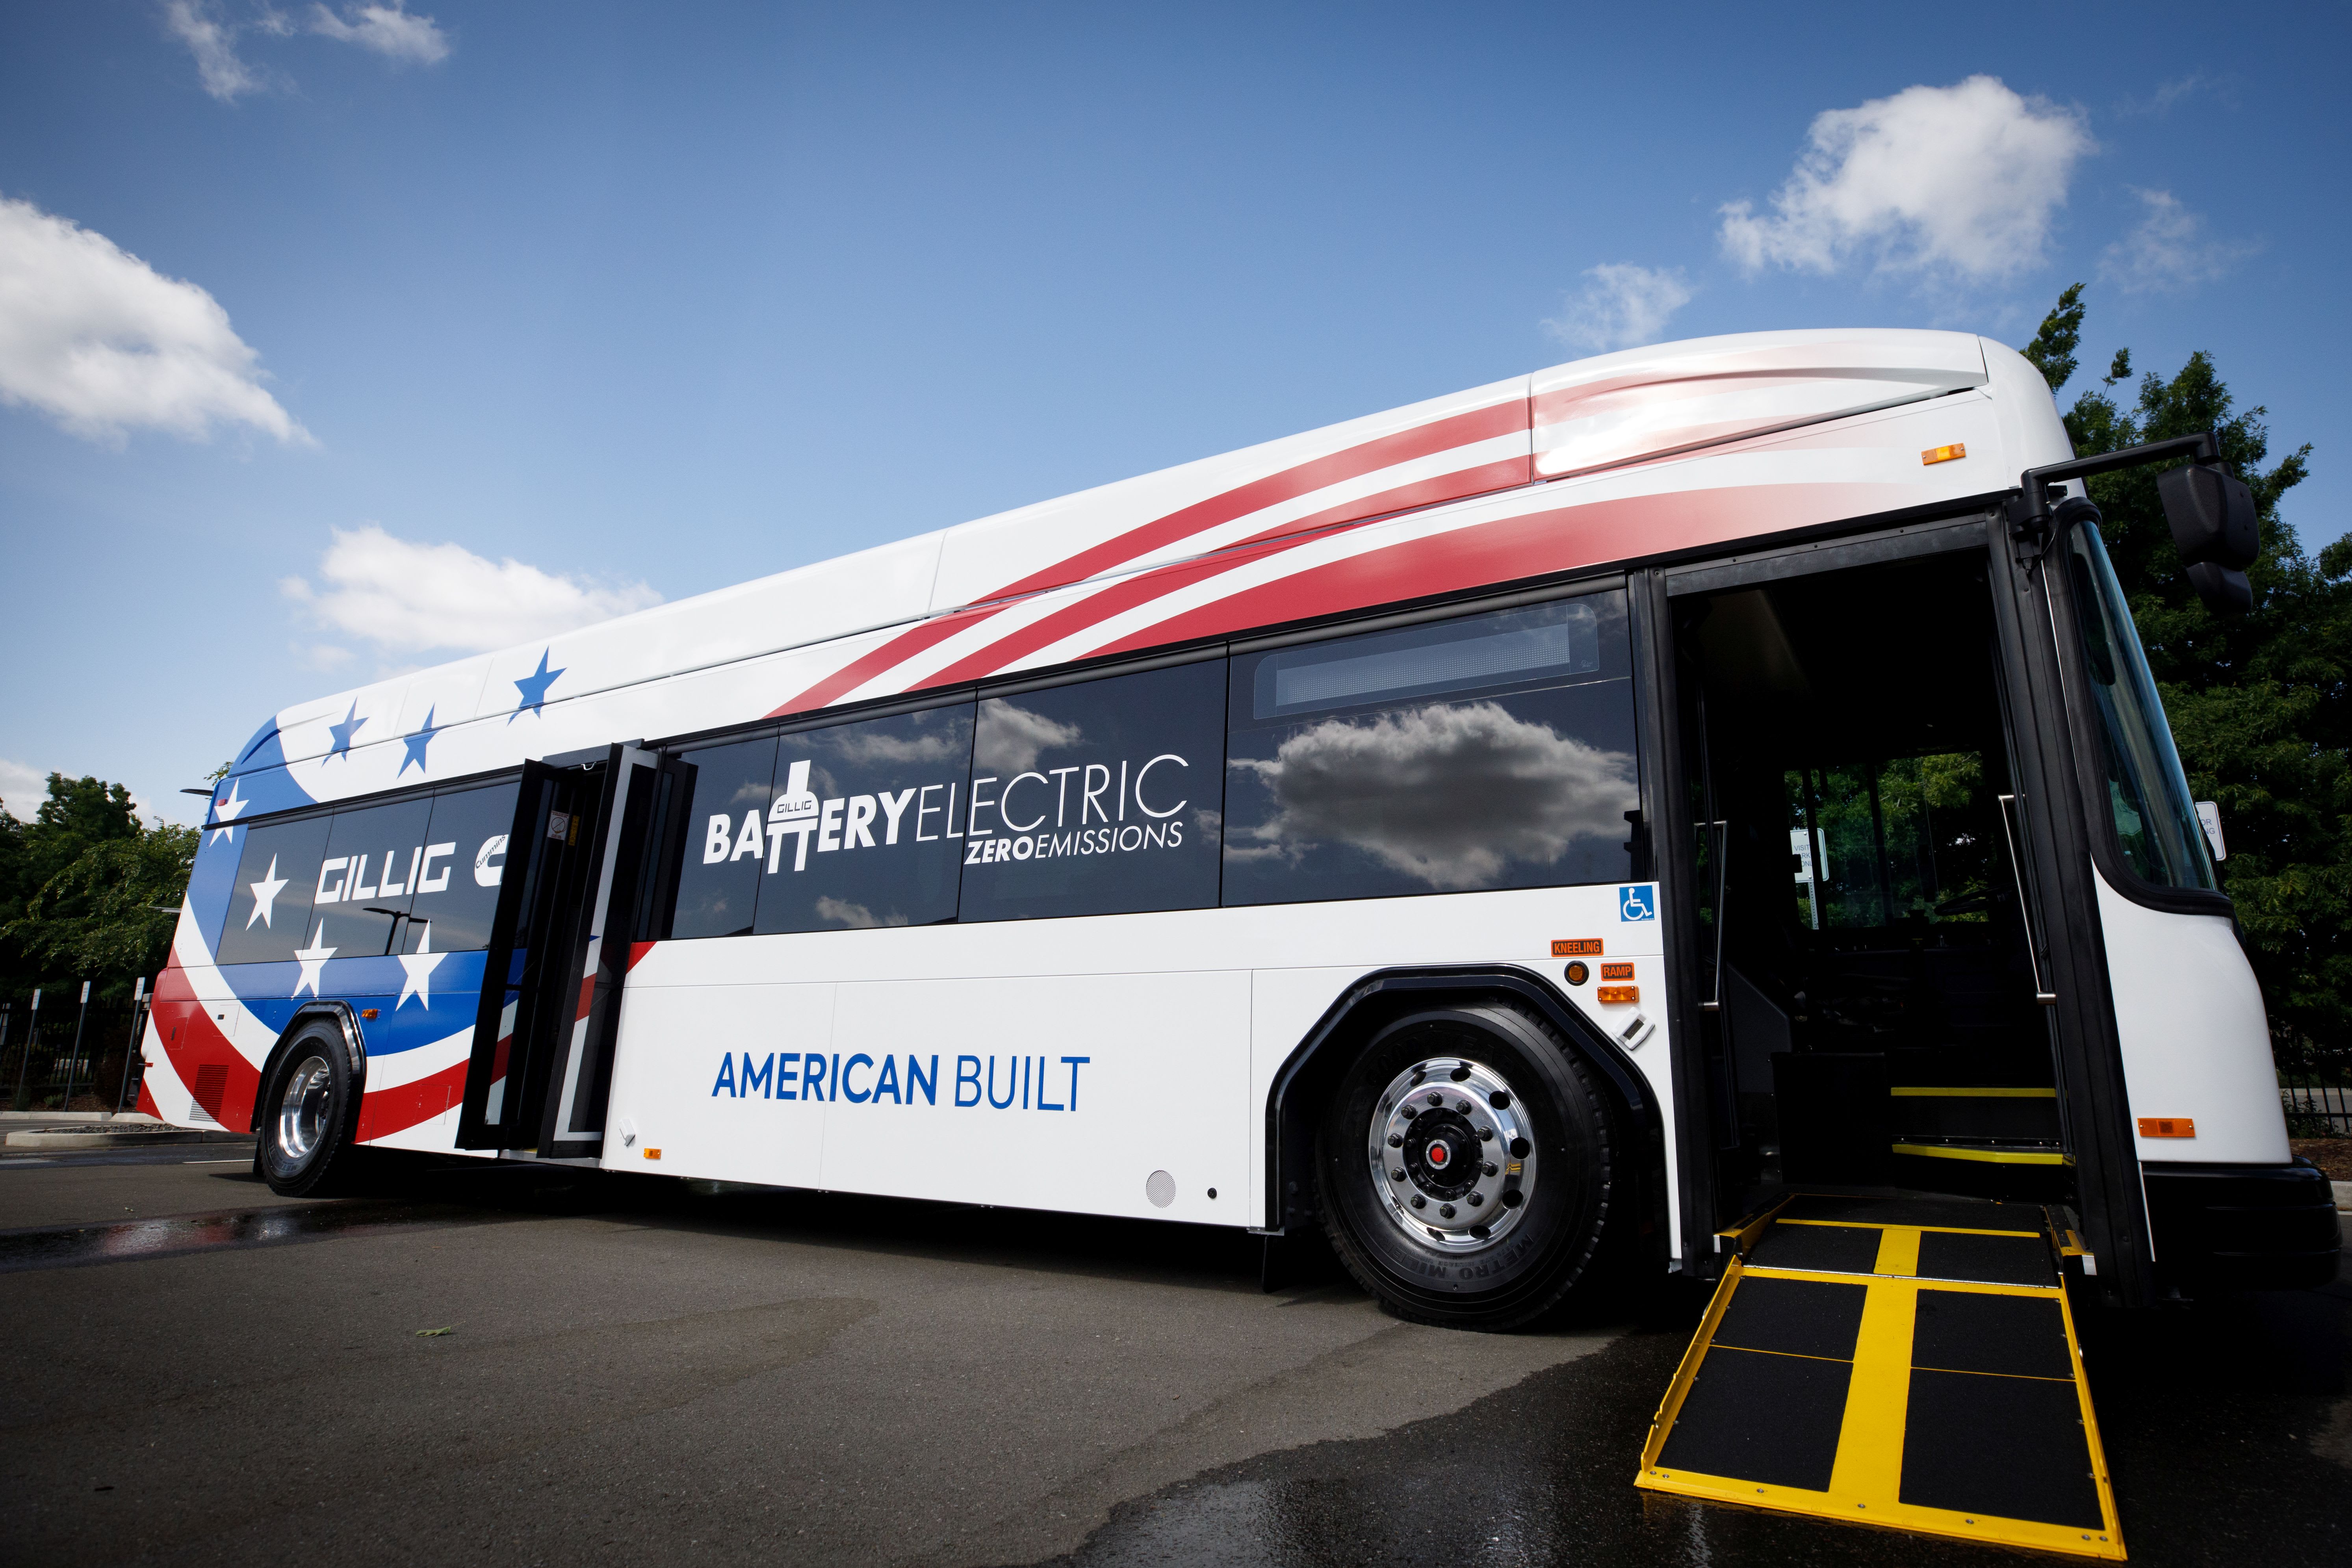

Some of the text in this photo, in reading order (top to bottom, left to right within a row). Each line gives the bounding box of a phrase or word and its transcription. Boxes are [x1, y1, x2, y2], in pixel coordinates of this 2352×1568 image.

[777, 800, 812, 813] GILLIG
[476, 835, 506, 869] Cummins
[314, 842, 456, 904] GILLIG
[1554, 941, 1600, 954] KNEELING
[1604, 966, 1631, 976] RAMP
[711, 1052, 1090, 1112] AMERICAN BUILT
